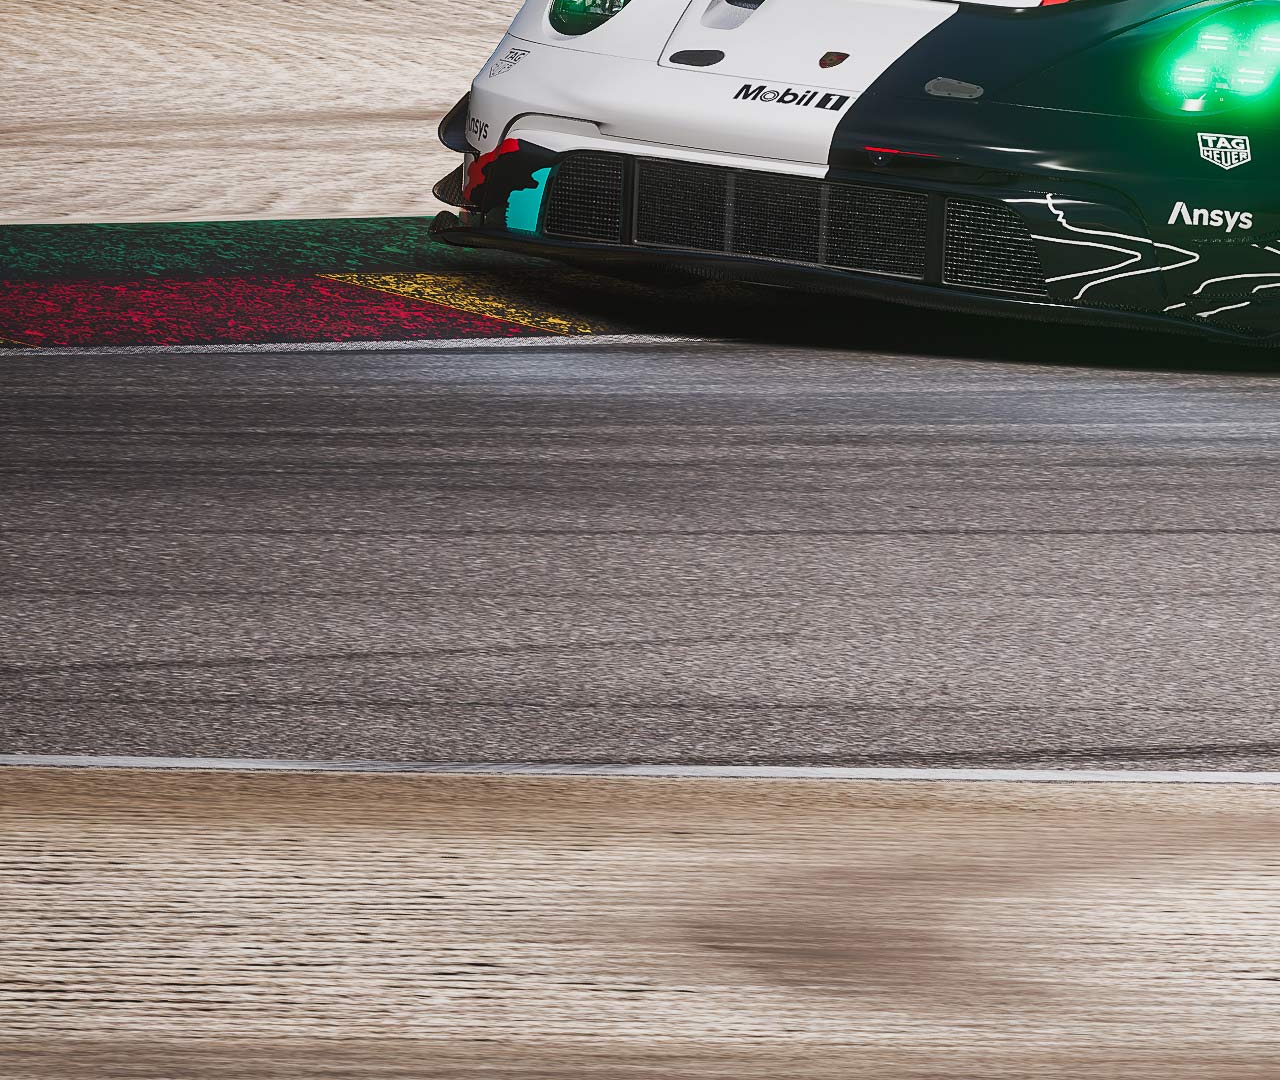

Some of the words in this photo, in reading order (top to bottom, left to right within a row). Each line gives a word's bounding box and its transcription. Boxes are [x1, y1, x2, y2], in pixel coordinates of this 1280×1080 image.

[733, 84, 820, 107] Mobil
[1202, 135, 1246, 149] TAG
[1202, 149, 1249, 167] HEUER
[1167, 201, 1254, 233] Ansys
